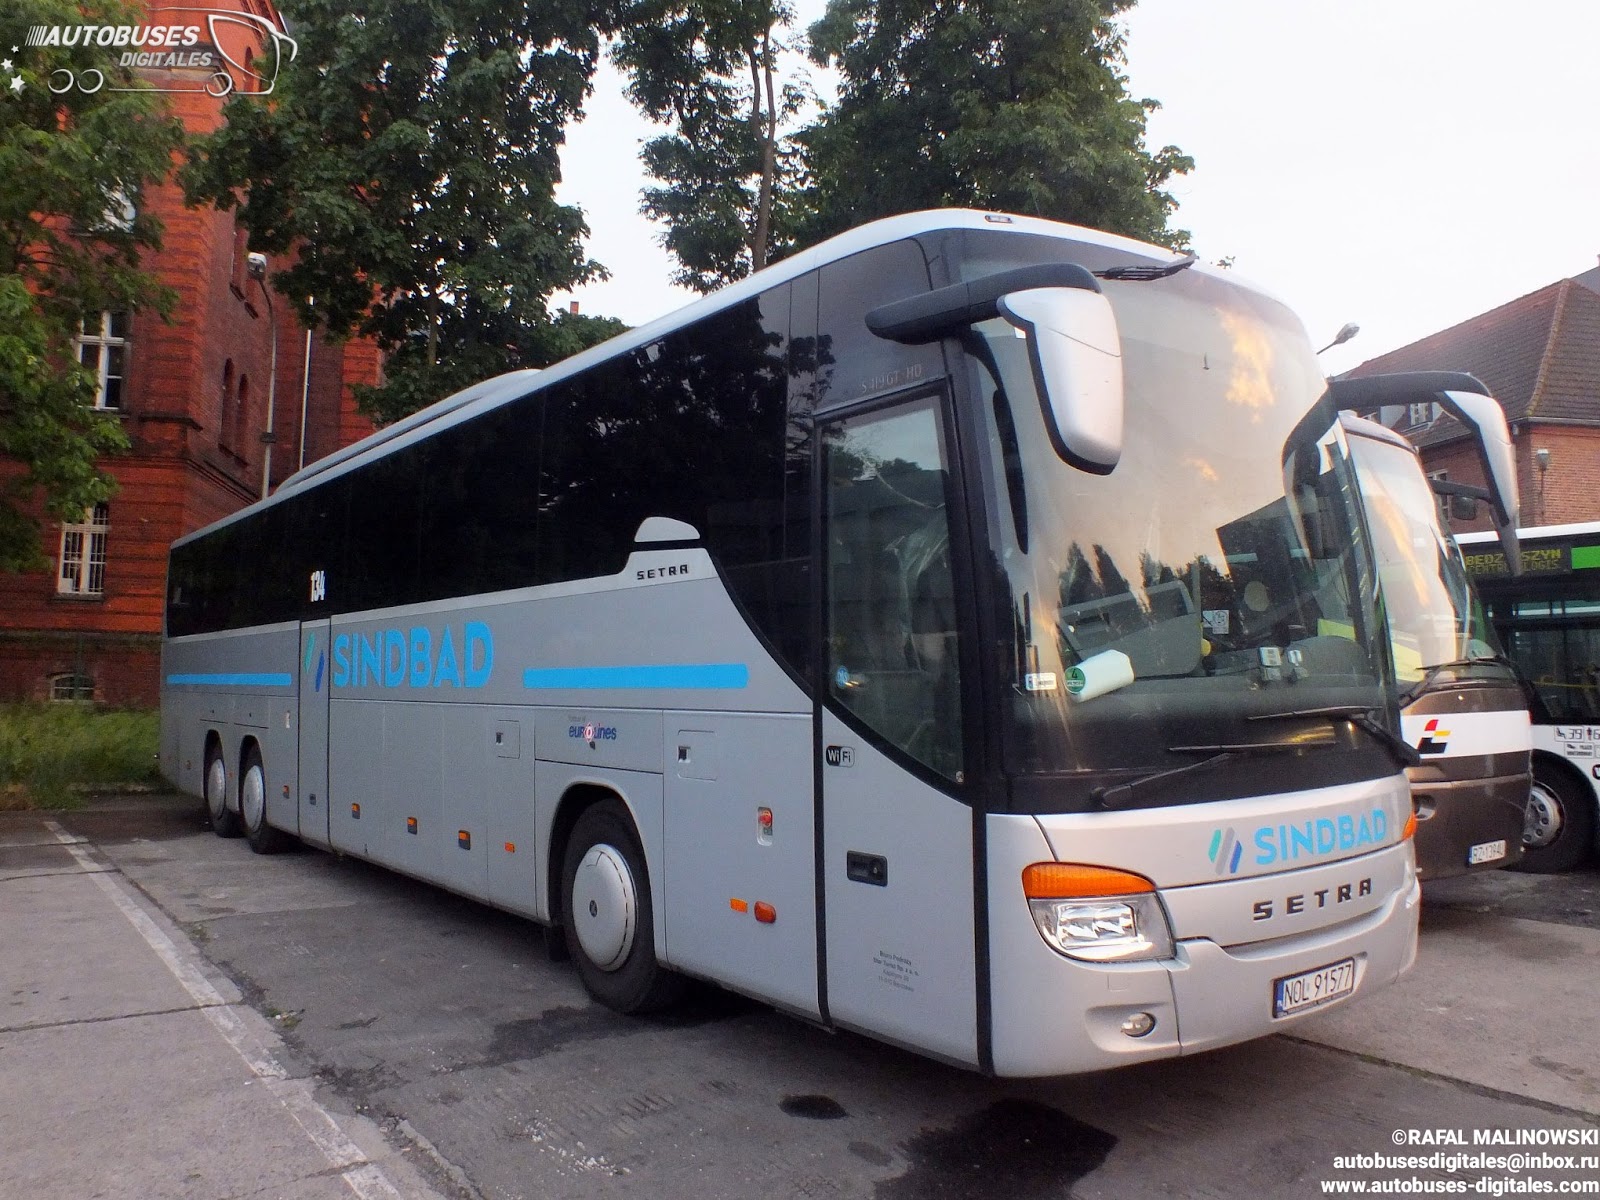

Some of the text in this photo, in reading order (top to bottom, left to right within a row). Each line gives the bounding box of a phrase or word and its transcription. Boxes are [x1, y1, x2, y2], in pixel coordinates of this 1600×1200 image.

[636, 564, 688, 580] SETRA
[333, 620, 495, 689] SINDBAD
[1254, 808, 1386, 865] SINDBAD
[1253, 878, 1372, 921] SETRA
[1284, 978, 1310, 1007] NOL
[1314, 963, 1352, 998] 91577
